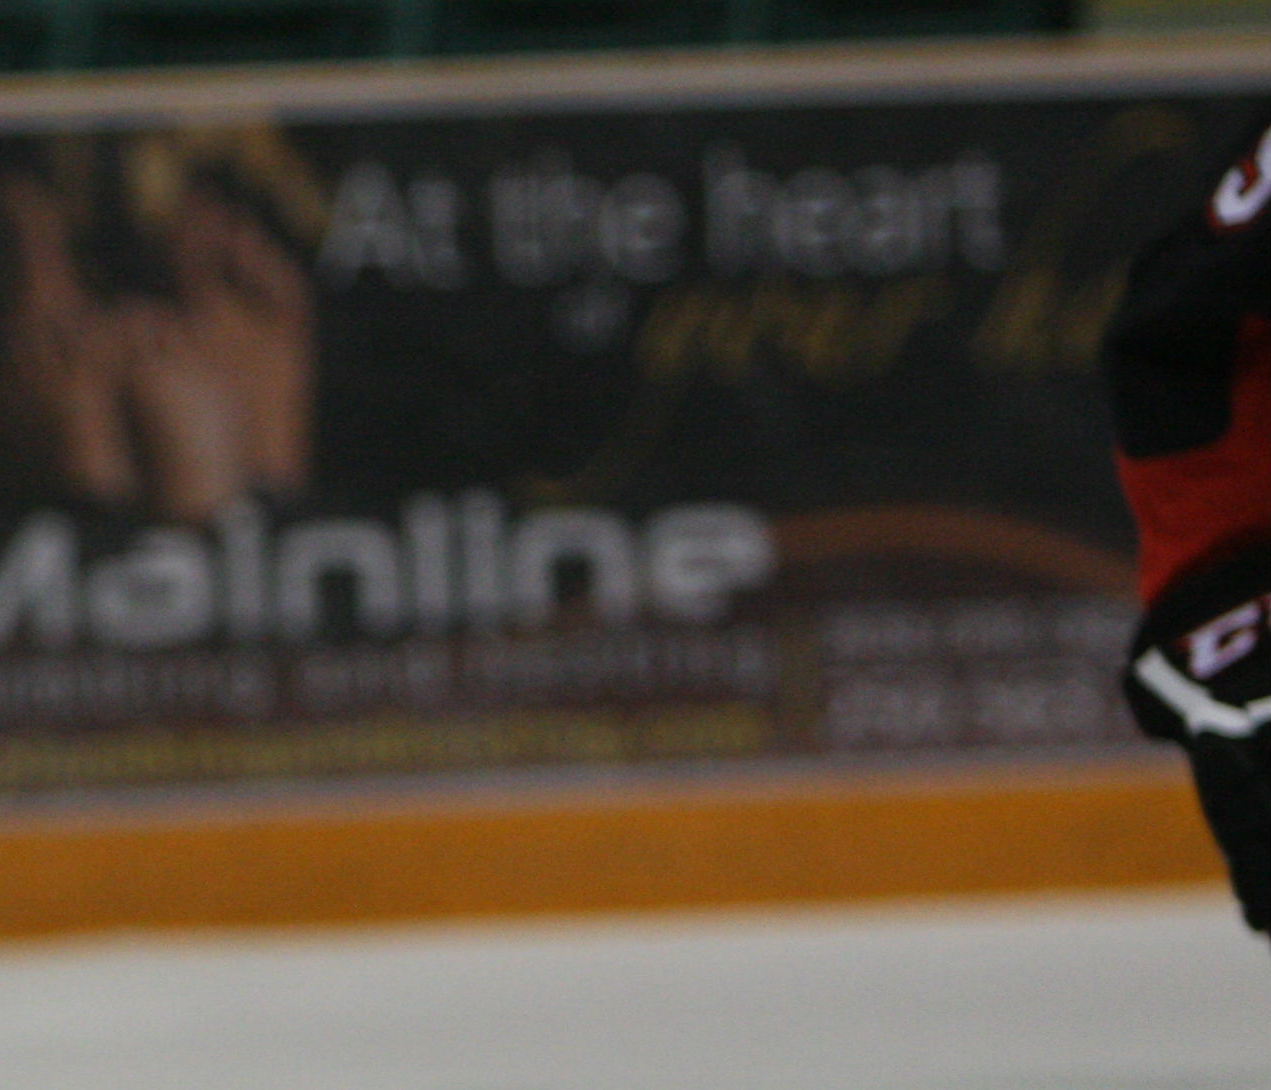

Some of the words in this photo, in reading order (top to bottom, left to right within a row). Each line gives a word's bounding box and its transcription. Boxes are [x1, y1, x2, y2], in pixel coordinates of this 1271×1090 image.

[323, 163, 465, 288] At
[487, 150, 685, 286] the
[705, 144, 1007, 276] heart
